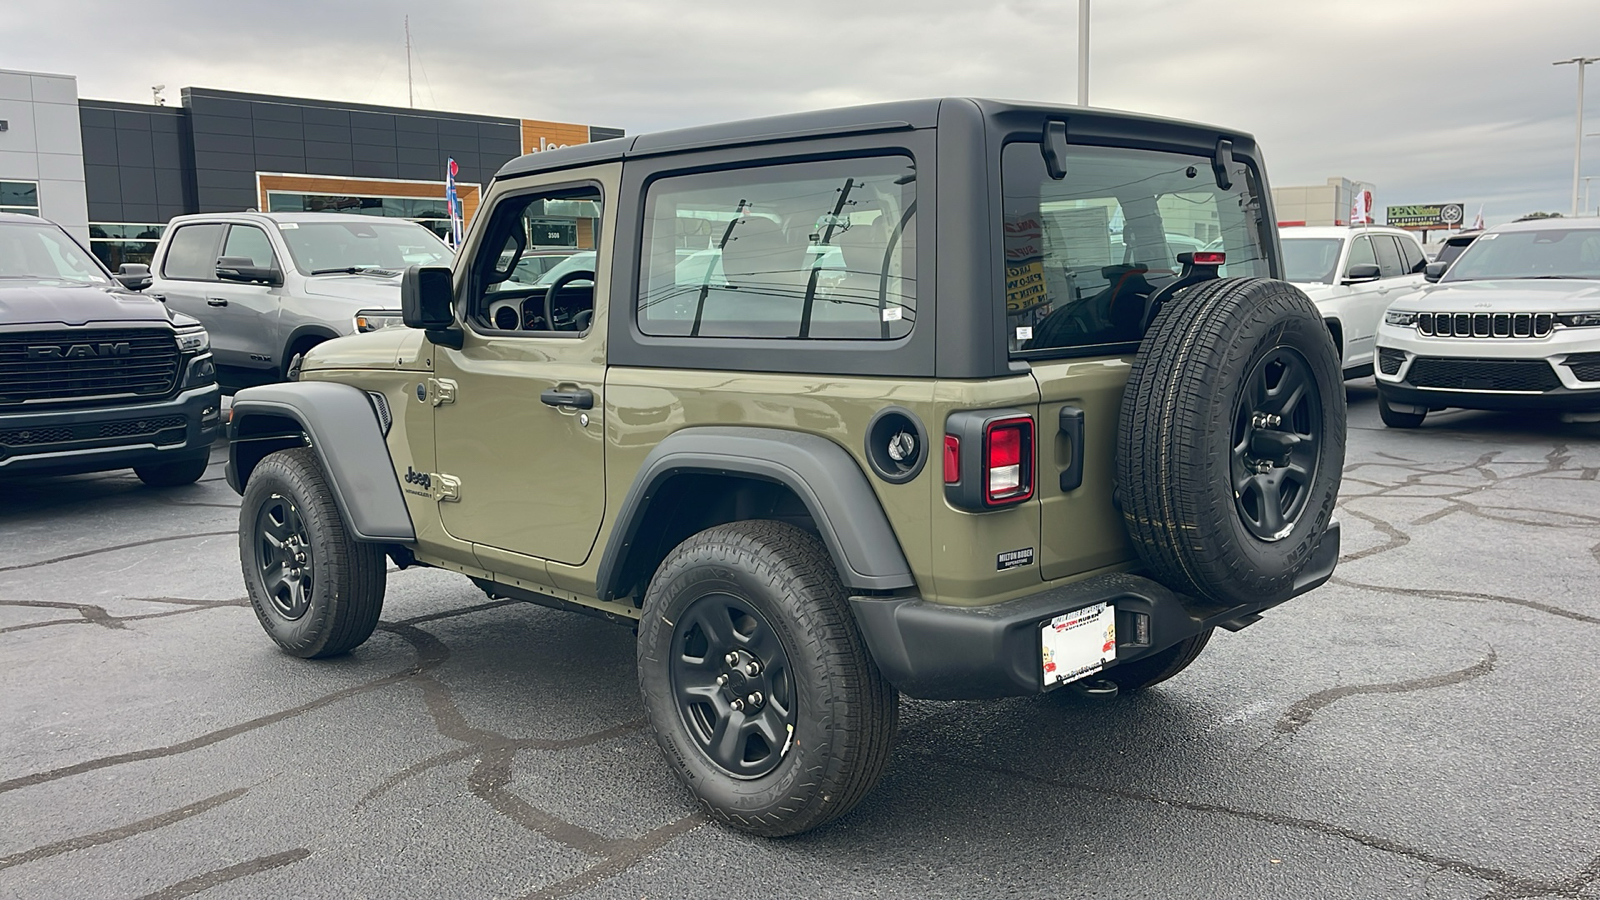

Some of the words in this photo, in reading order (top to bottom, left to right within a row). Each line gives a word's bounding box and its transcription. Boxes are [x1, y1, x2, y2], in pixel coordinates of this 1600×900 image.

[28, 343, 130, 358] RAM
[250, 353, 273, 362] RAM
[405, 466, 431, 490] Jeep
[1287, 490, 1333, 565] NEXEN
